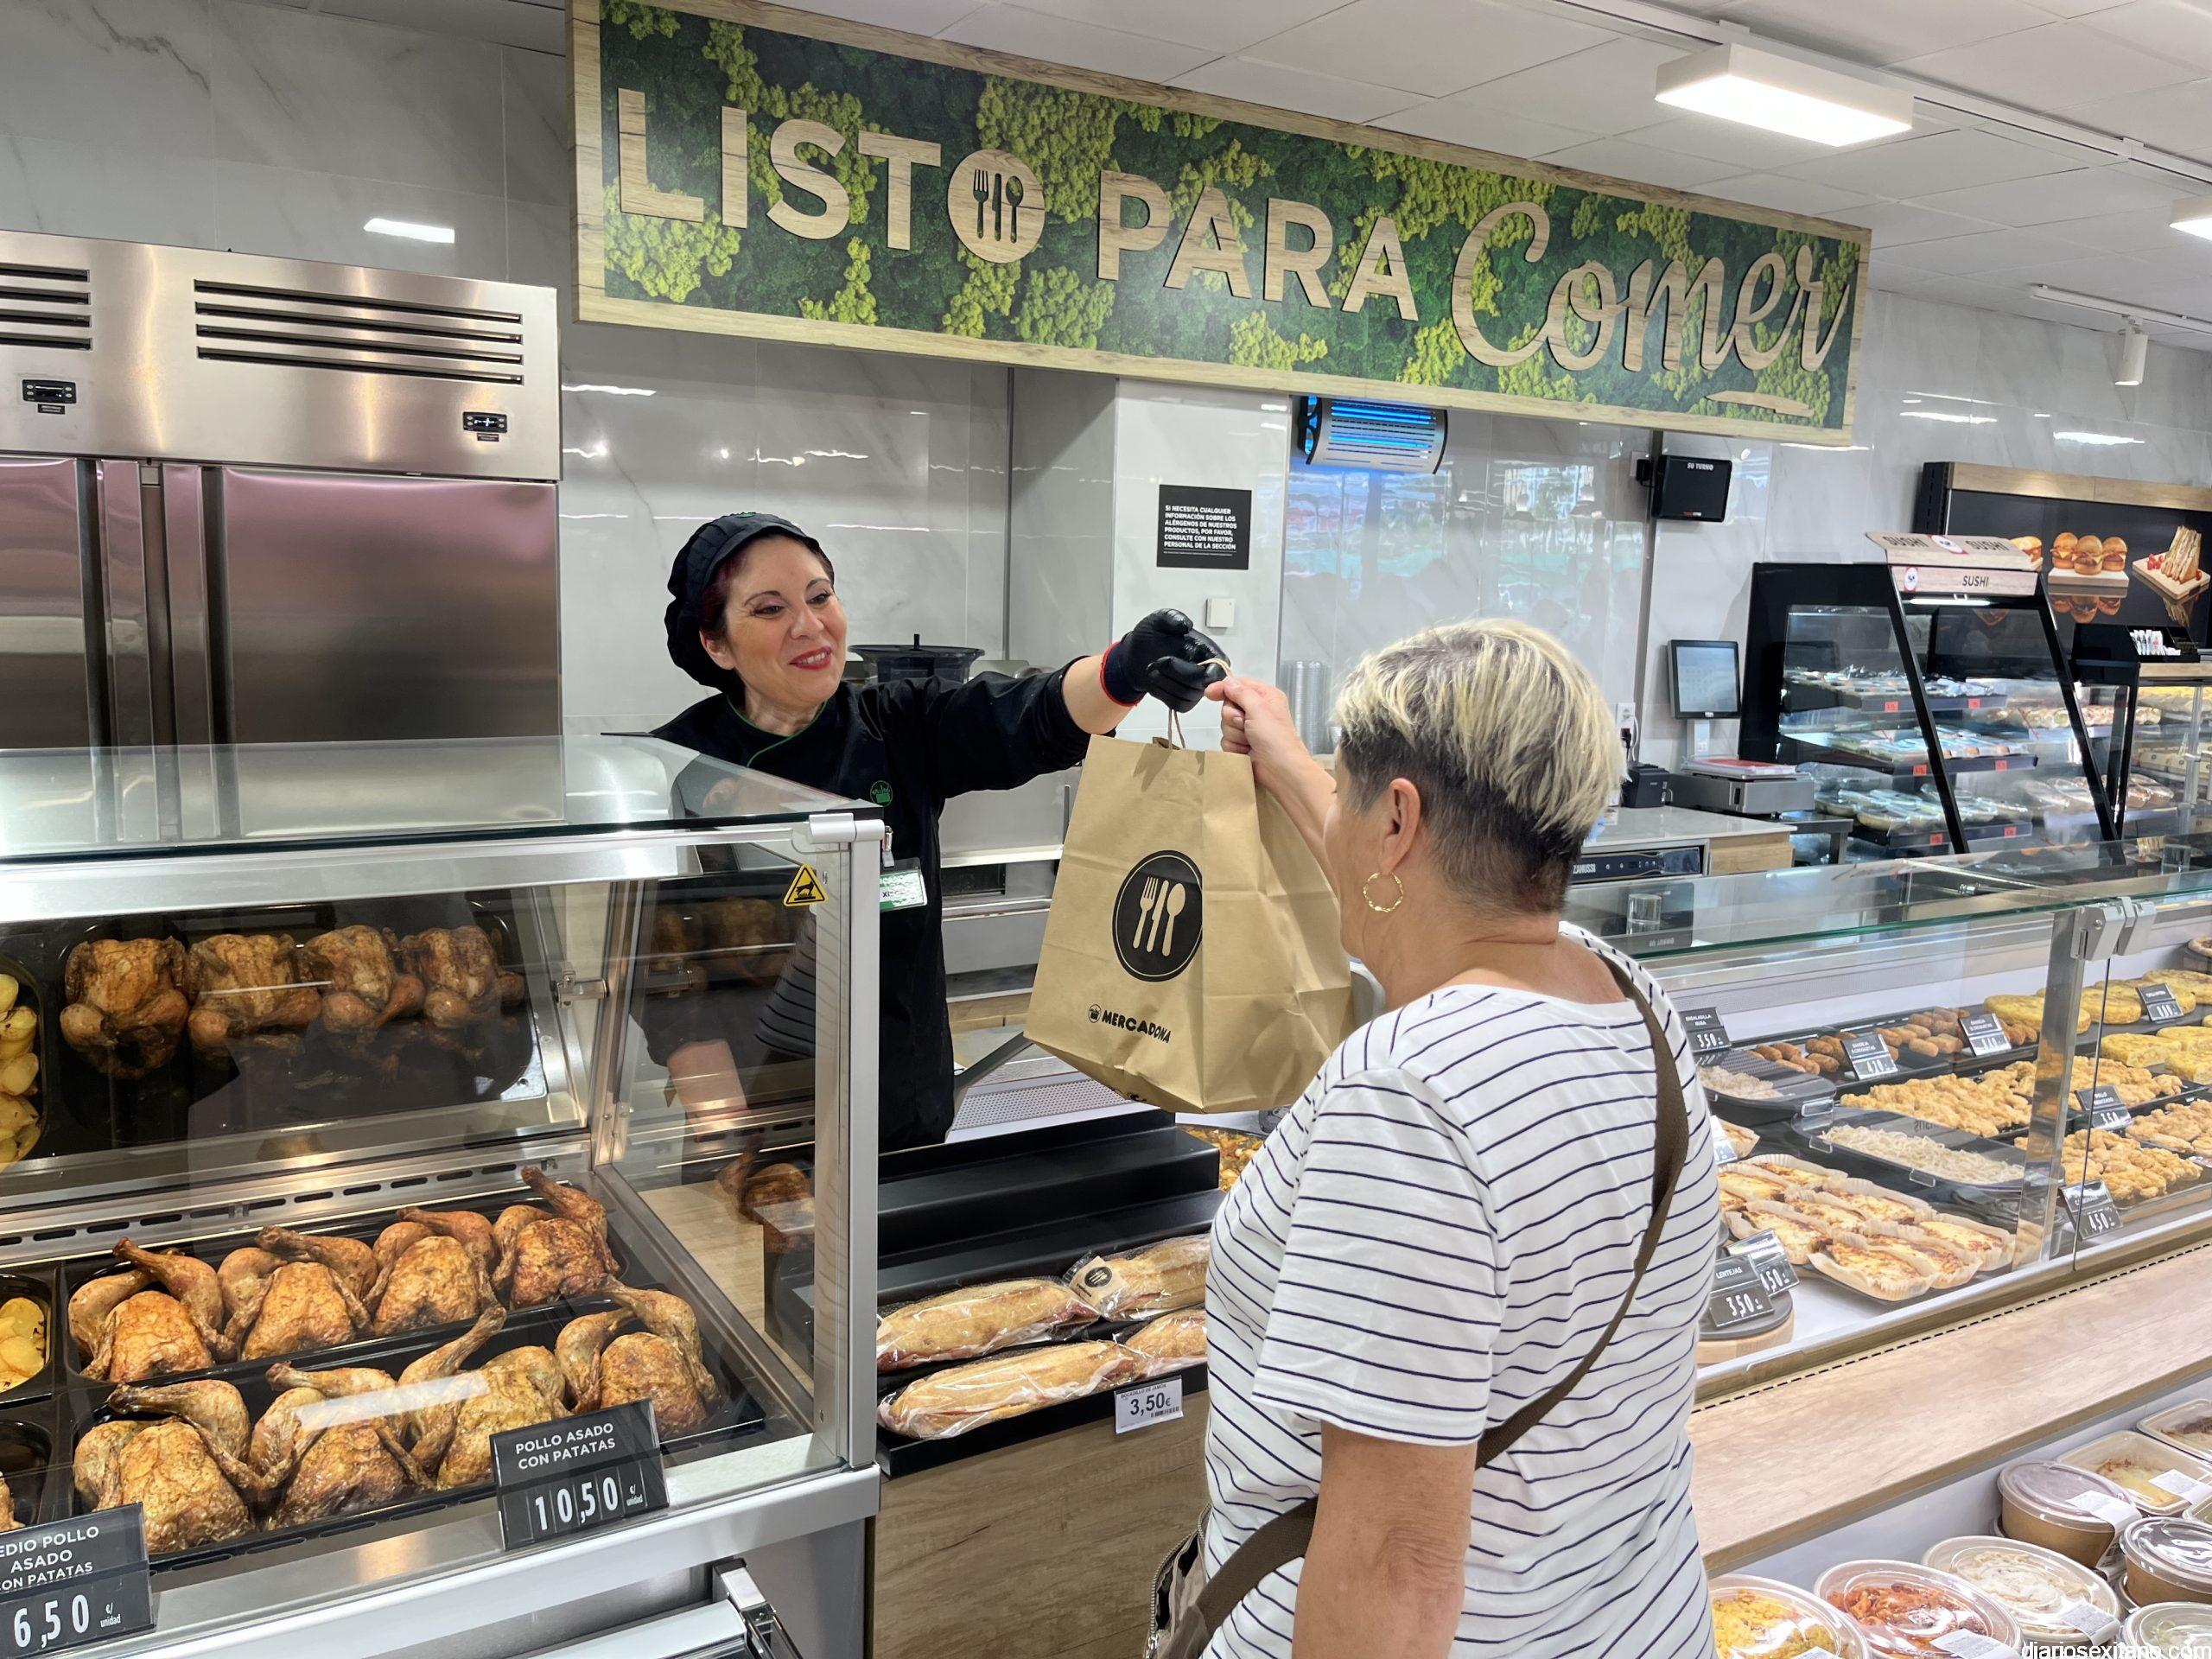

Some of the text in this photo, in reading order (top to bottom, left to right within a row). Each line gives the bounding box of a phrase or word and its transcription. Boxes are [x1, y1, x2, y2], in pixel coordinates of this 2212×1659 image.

[618, 87, 1849, 372] LISTO PARA Comer
[1695, 462, 1714, 471] TURNO
[1882, 536, 1929, 548] SUSHI
[1964, 539, 2011, 551] SUSHI
[1962, 575, 1989, 588] SUSHI
[1572, 863, 1596, 874] ZANUSSI
[1102, 1009, 1172, 1044] MERCADONA
[1715, 1267, 1743, 1279] LENTEJAS
[515, 1423, 614, 1454] POLLO ASADO
[518, 1438, 616, 1470] CON PATATAS
[535, 1477, 619, 1531] 10,50
[43, 1526, 99, 1548] POLLO
[10, 1549, 73, 1573] ASADO
[0, 1562, 93, 1591] ON PATATAS
[14, 1594, 90, 1649] 6,50
[100, 1613, 121, 1628] unidad
